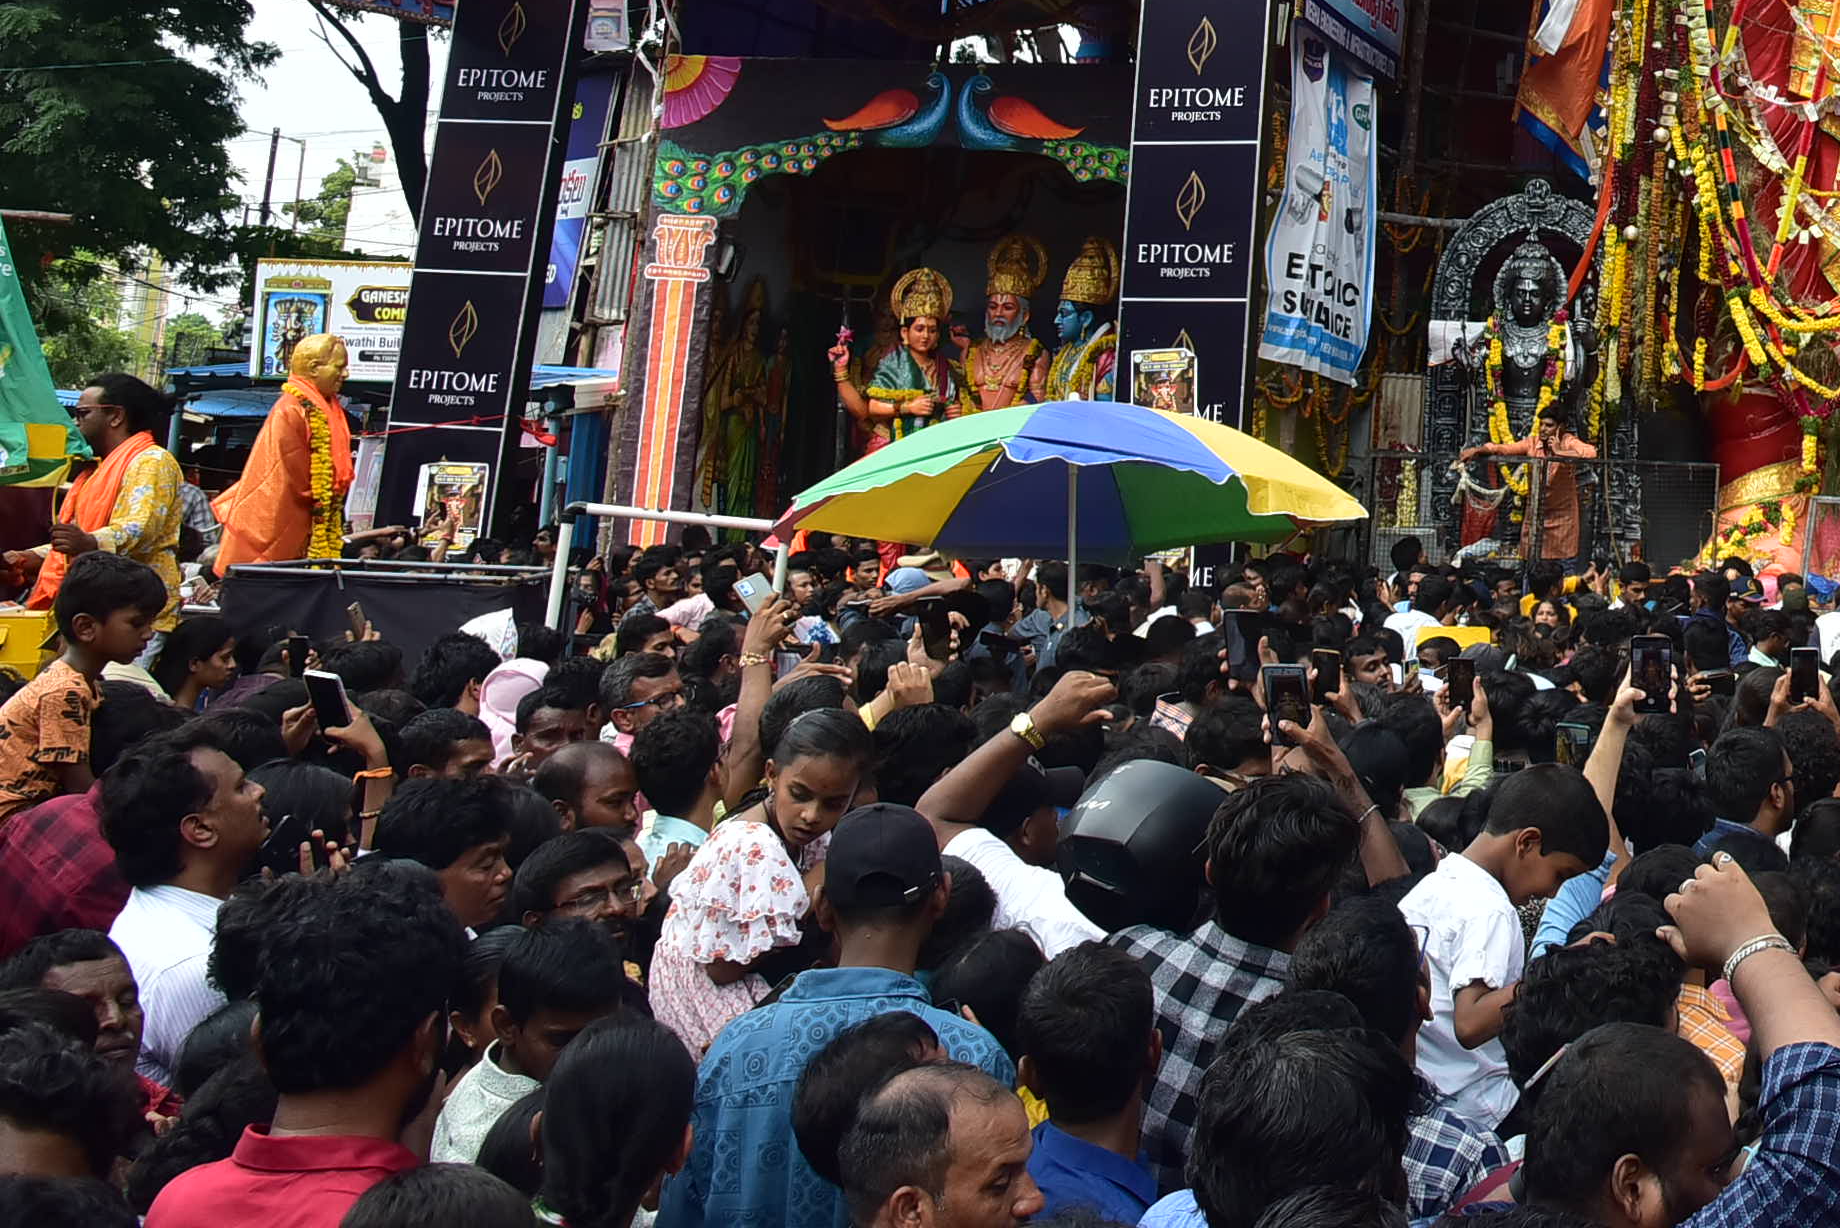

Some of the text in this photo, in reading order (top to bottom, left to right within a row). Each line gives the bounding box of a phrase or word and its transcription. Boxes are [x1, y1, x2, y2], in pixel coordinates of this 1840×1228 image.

[1137, 243, 1234, 264] EPITOME
[1159, 267, 1211, 279] PROJECTS
[408, 369, 499, 393] EPITOME
[427, 394, 476, 406] PROJECTS
